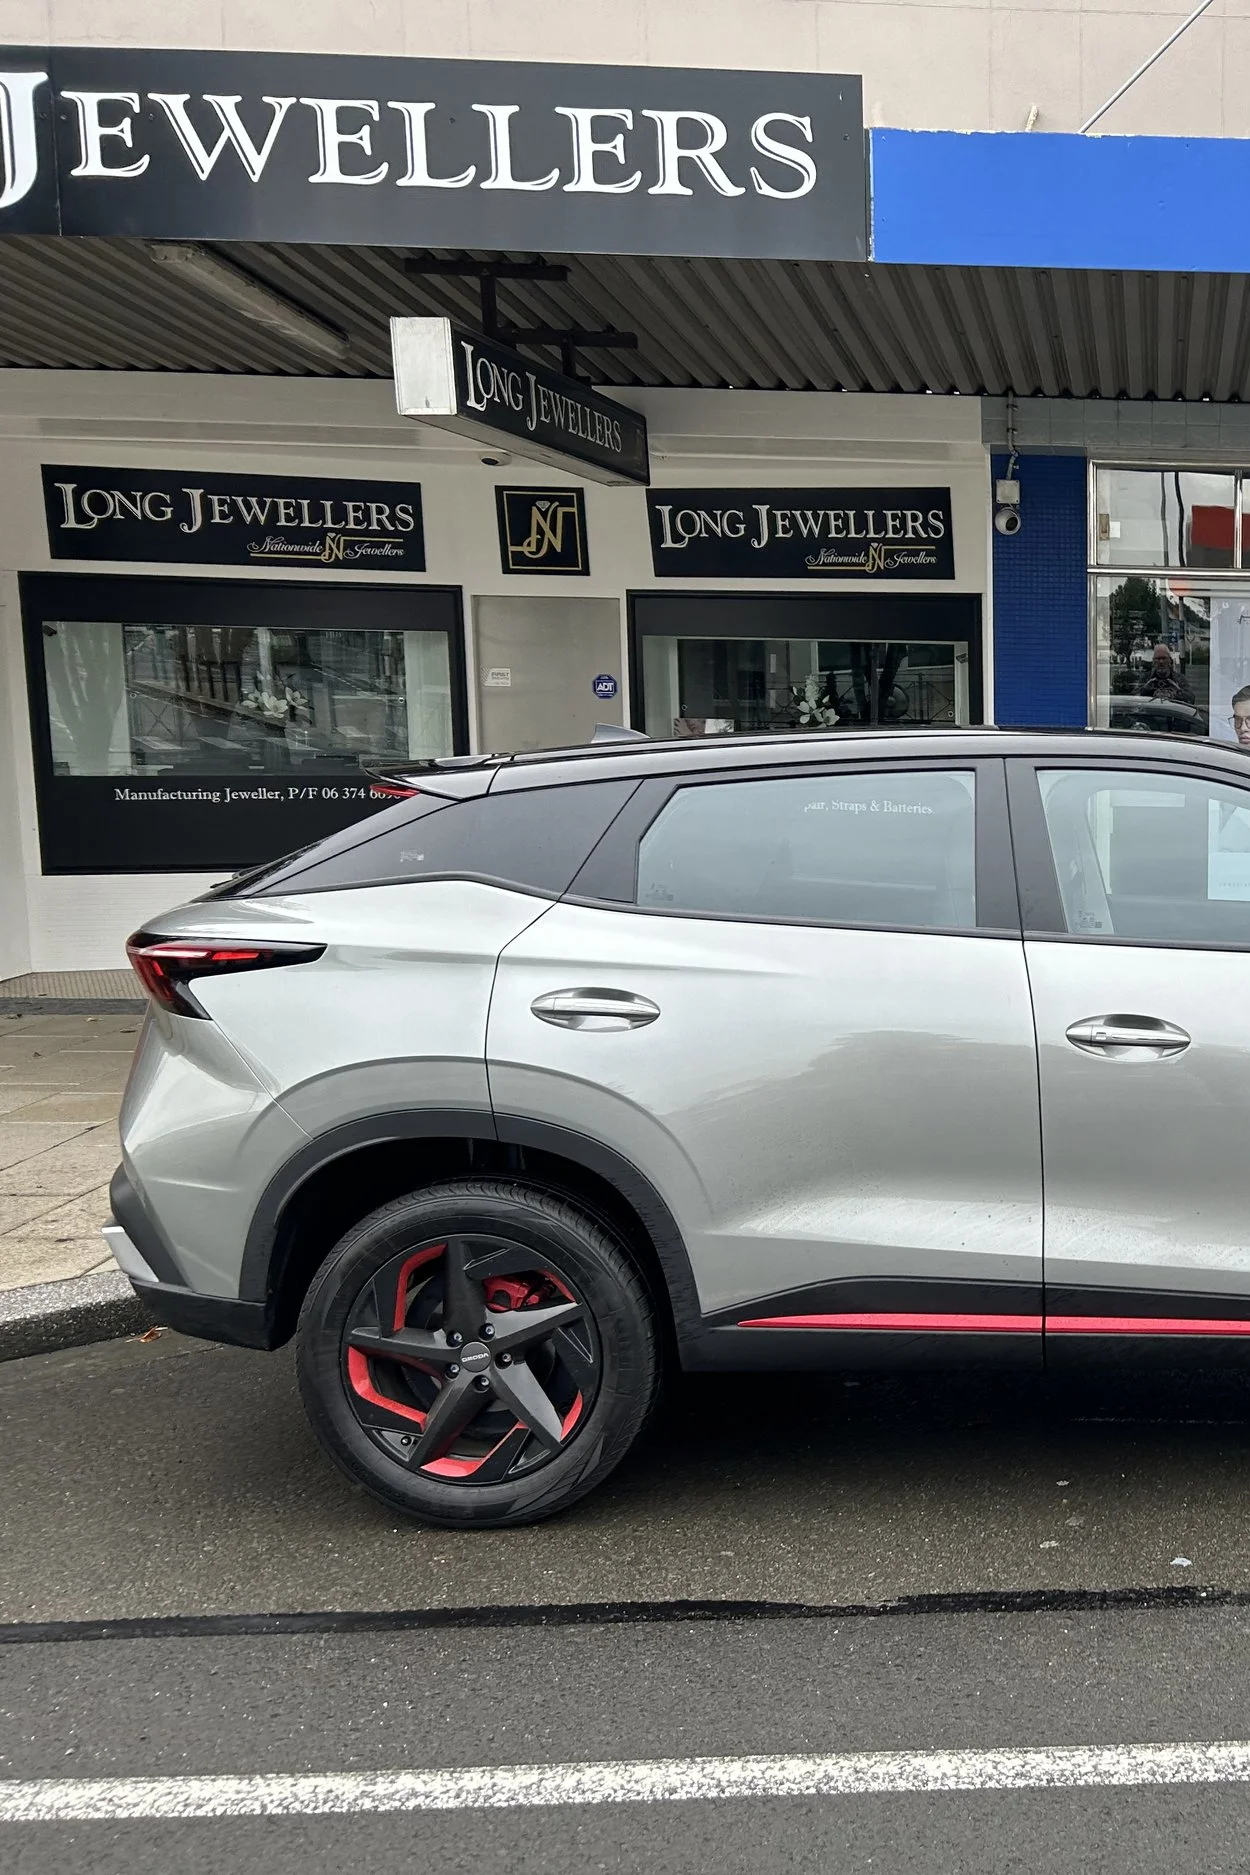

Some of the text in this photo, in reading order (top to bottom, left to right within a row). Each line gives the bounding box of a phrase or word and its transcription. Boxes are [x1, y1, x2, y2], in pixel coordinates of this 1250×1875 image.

[0, 71, 819, 208] JEWELLERS
[461, 340, 622, 453] LONG JEWELLERS
[54, 482, 415, 534] LONG JEWELLERS
[655, 503, 945, 549] LONG JEWELLERS
[247, 535, 323, 556] Nationwide
[344, 542, 404, 560] Jewellers
[805, 548, 868, 566] Nationwide
[885, 552, 937, 569] Jewellers
[596, 682, 614, 691] ADT
[114, 787, 221, 803] Manufacturing
[224, 787, 285, 802] Jeweller,
[288, 787, 318, 800] P/F
[322, 787, 339, 800] 06
[342, 787, 366, 800] 374
[831, 799, 867, 815] Straps
[869, 799, 880, 812] &
